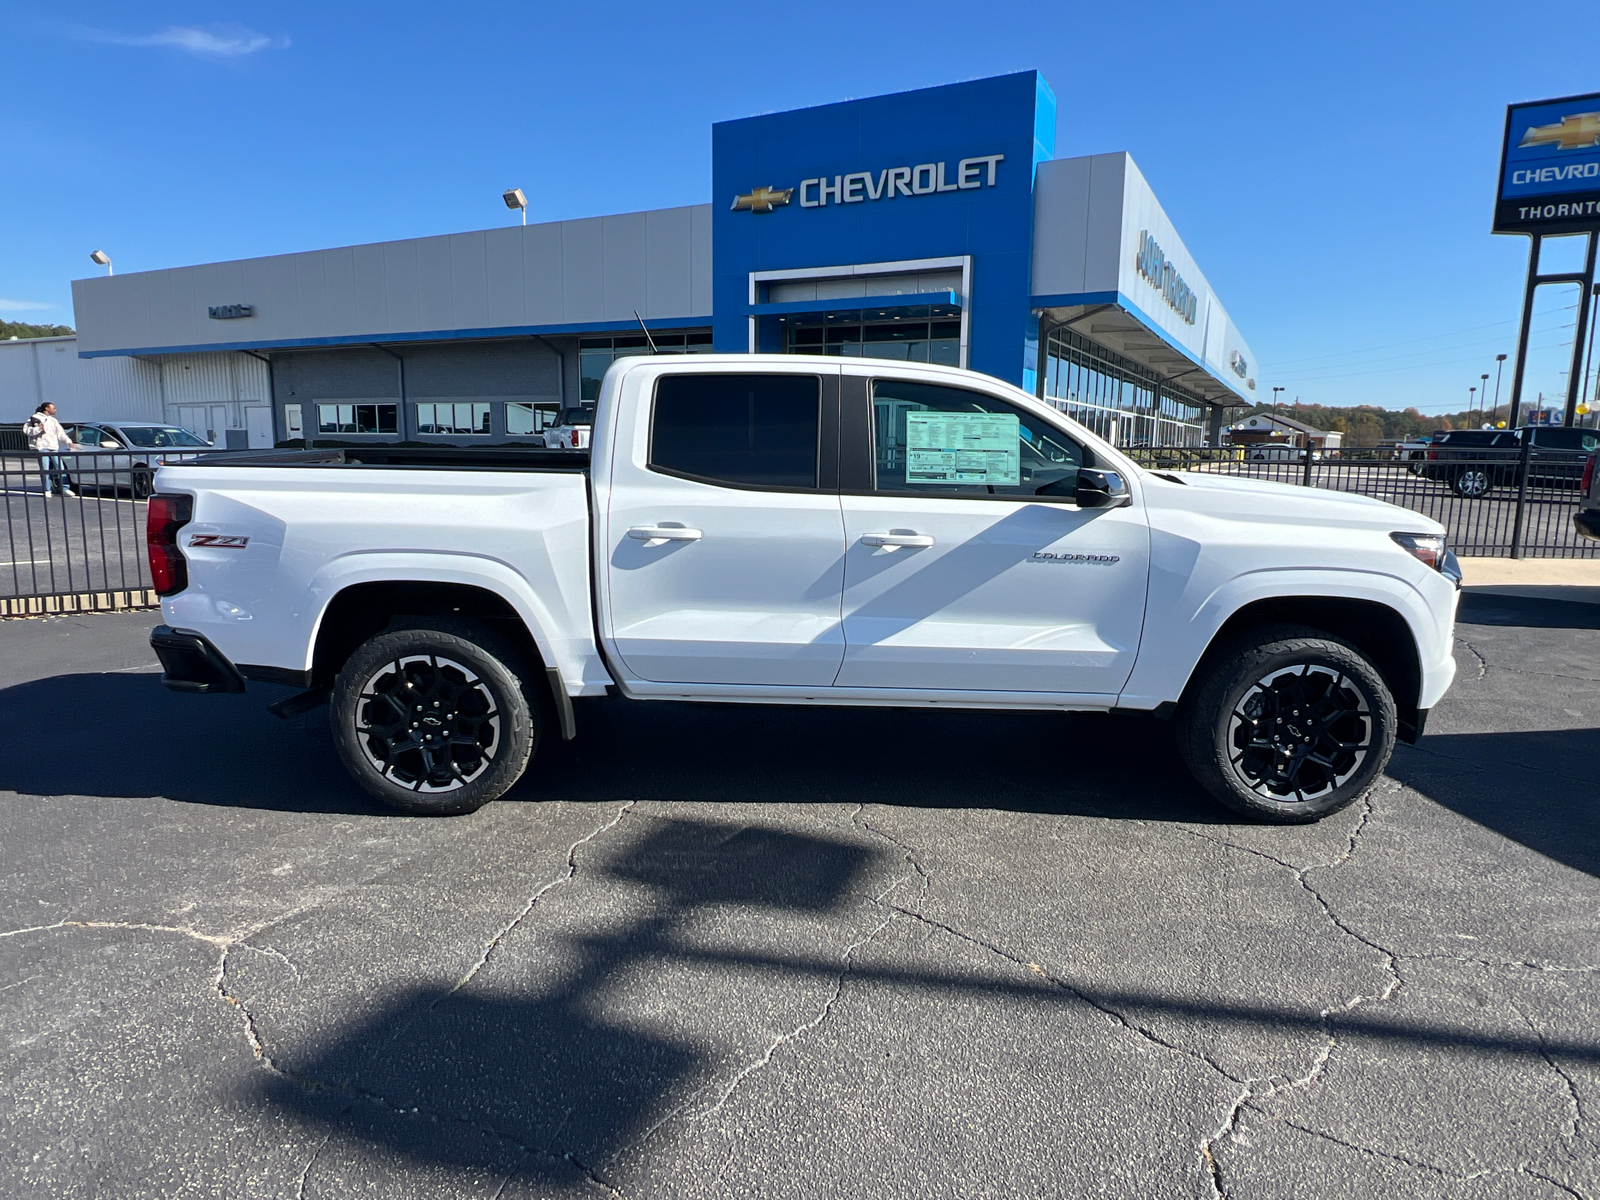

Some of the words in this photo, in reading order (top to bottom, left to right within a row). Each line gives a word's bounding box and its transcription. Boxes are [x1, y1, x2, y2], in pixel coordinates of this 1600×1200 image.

[800, 154, 1004, 208] CHEVROLET
[1512, 162, 1600, 185] CHEVRO
[188, 534, 251, 549] Z71
[1032, 552, 1120, 562] COLORADO
